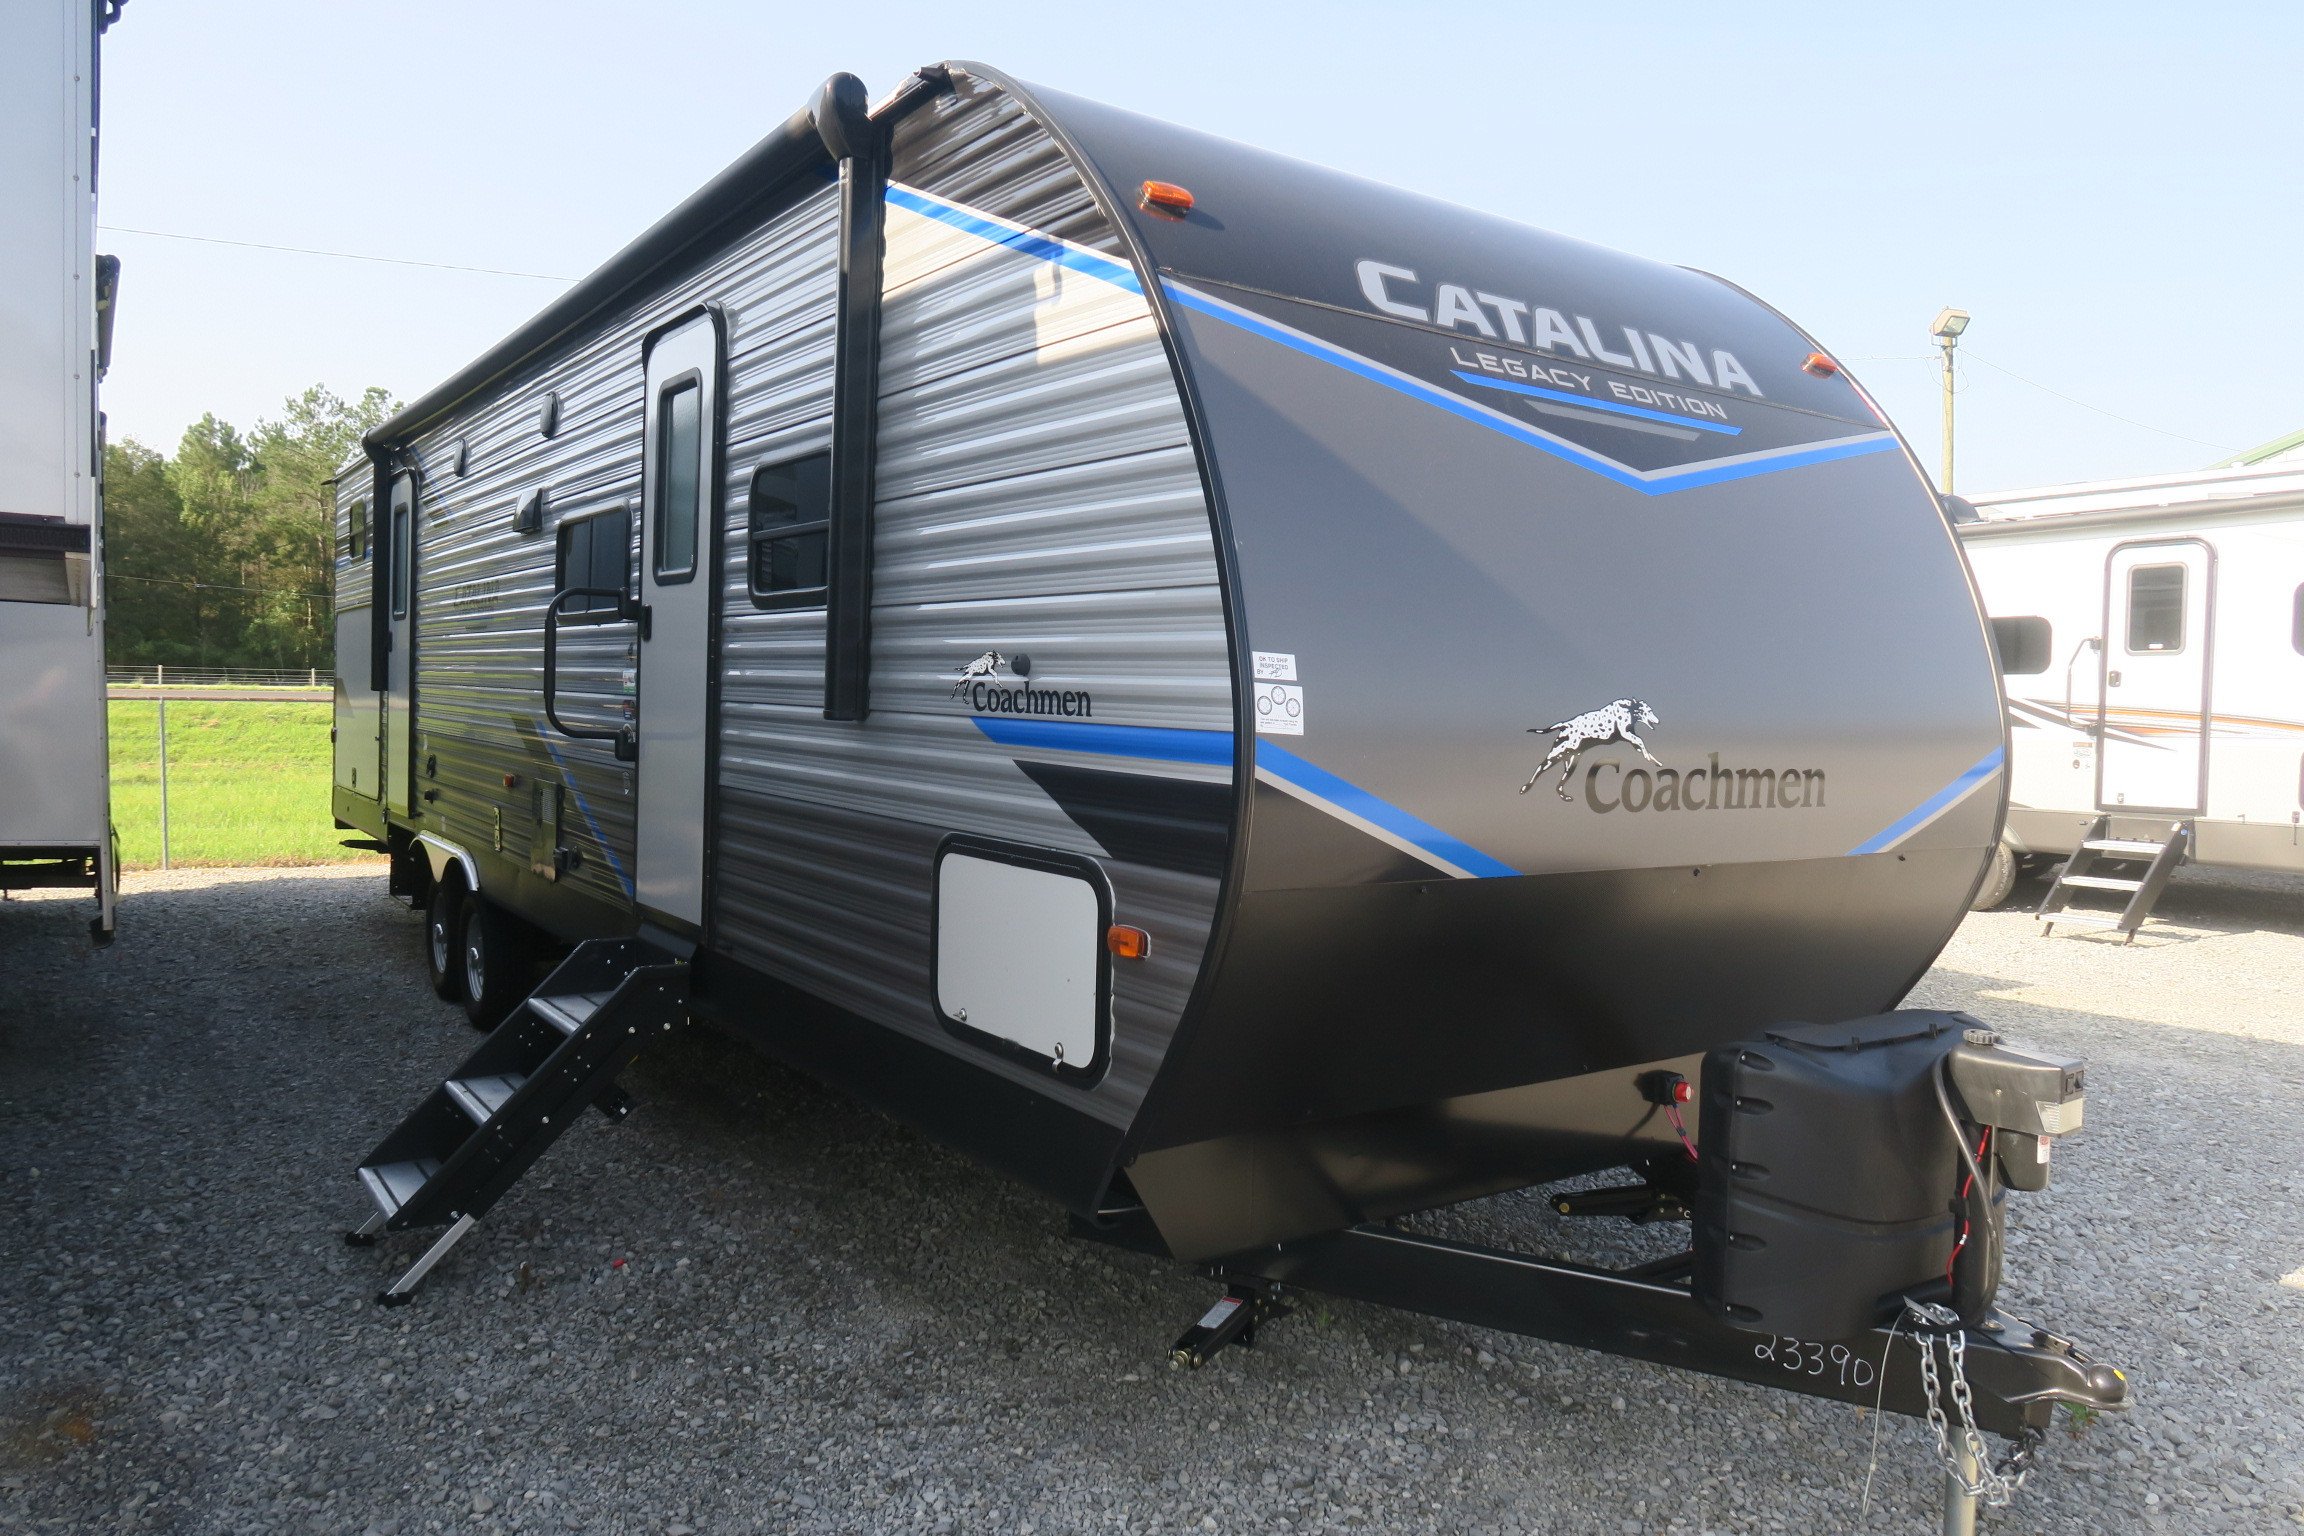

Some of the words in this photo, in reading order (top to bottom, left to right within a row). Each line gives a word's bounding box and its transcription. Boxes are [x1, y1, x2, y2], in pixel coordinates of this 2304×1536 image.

[1355, 259, 1764, 398] CATALINA
[1449, 346, 1592, 392] LEGACY
[1607, 380, 1728, 420] EDITION
[972, 681, 1092, 717] Coachmen
[1585, 752, 1826, 814] Coachmen
[1754, 1334, 1874, 1386] 23390
